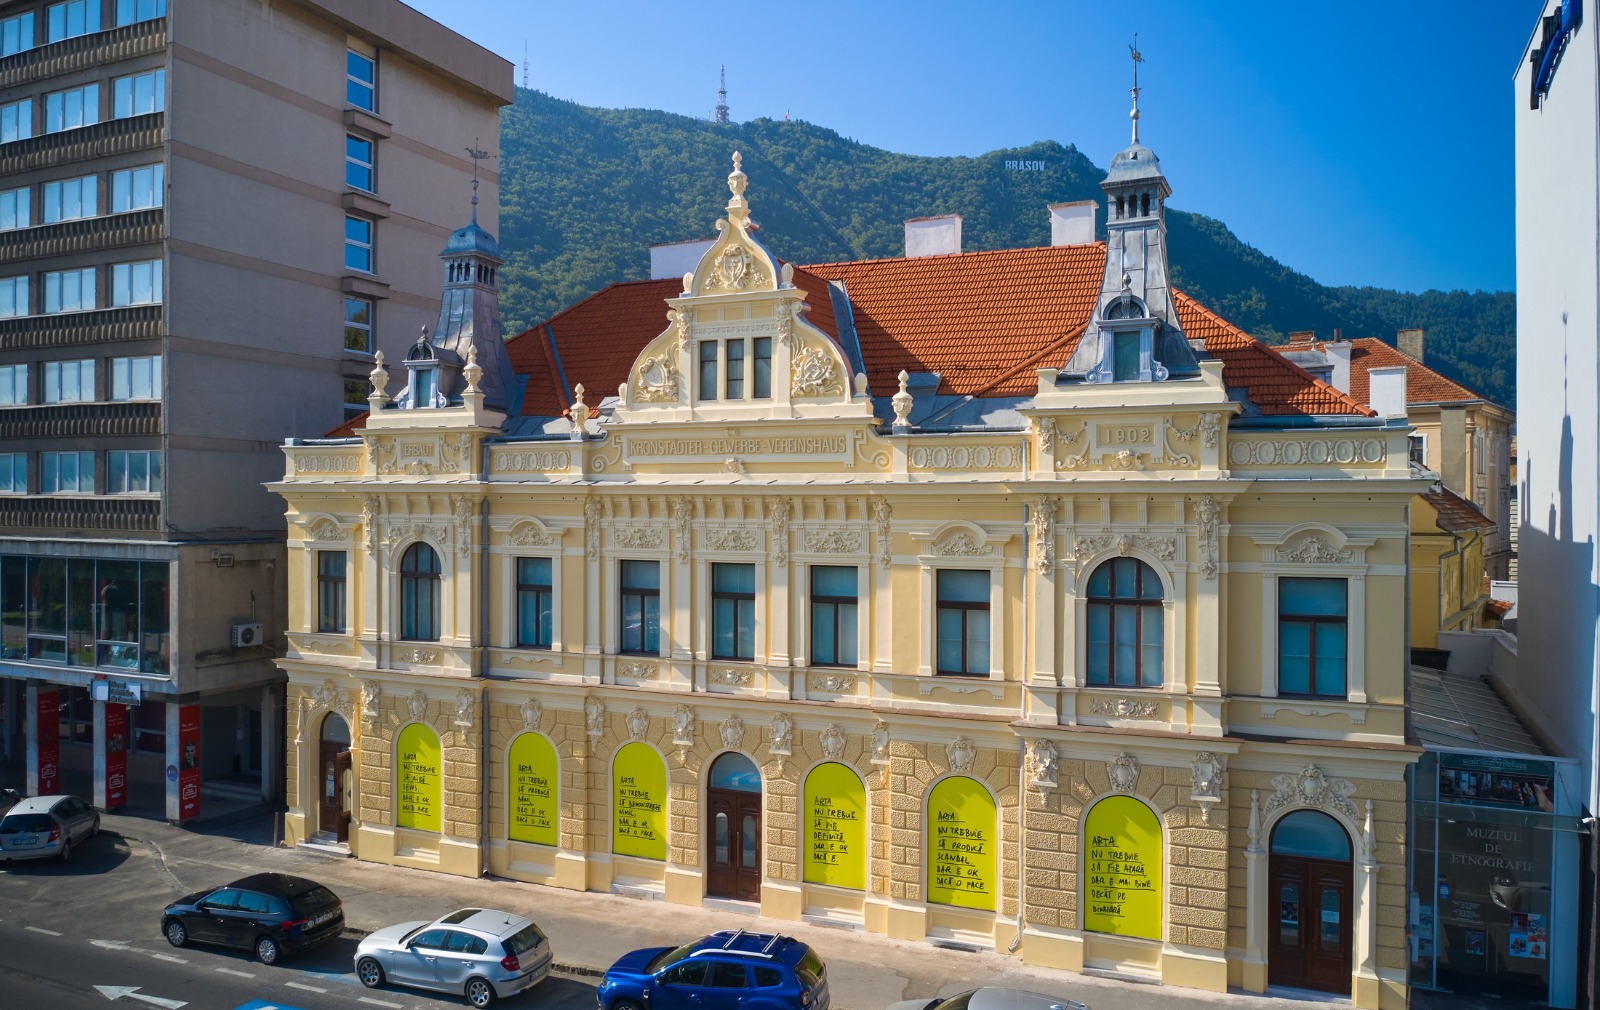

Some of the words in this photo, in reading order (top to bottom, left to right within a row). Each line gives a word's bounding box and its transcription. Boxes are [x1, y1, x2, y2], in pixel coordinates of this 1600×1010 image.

[1004, 160, 1046, 172] BRASOV
[1106, 428, 1152, 444] 1902
[404, 444, 434, 457] ERBAUT
[814, 796, 832, 806] ARTA
[814, 808, 824, 816] NU
[827, 809, 856, 819] TREBUIE
[937, 811, 955, 821] ARTA
[938, 826, 948, 836] NU
[950, 827, 983, 838] TREBUIE
[1466, 827, 1521, 842] MUZEUL
[814, 843, 825, 851] DAR
[830, 843, 836, 851] E
[1092, 836, 1115, 847] ARTA
[1485, 843, 1503, 854] DE
[1092, 850, 1103, 860] NU
[1108, 851, 1139, 861] TREBUIE
[1107, 862, 1120, 873] FIE
[1452, 853, 1537, 872] ETNOGRAFIE
[937, 865, 951, 874] DAR
[956, 867, 962, 876] E
[967, 868, 979, 877] OK
[956, 879, 962, 887] O
[966, 881, 985, 890] FACE
[1091, 875, 1106, 885] DAR
[1109, 877, 1114, 886] E
[1117, 891, 1127, 901] PE
